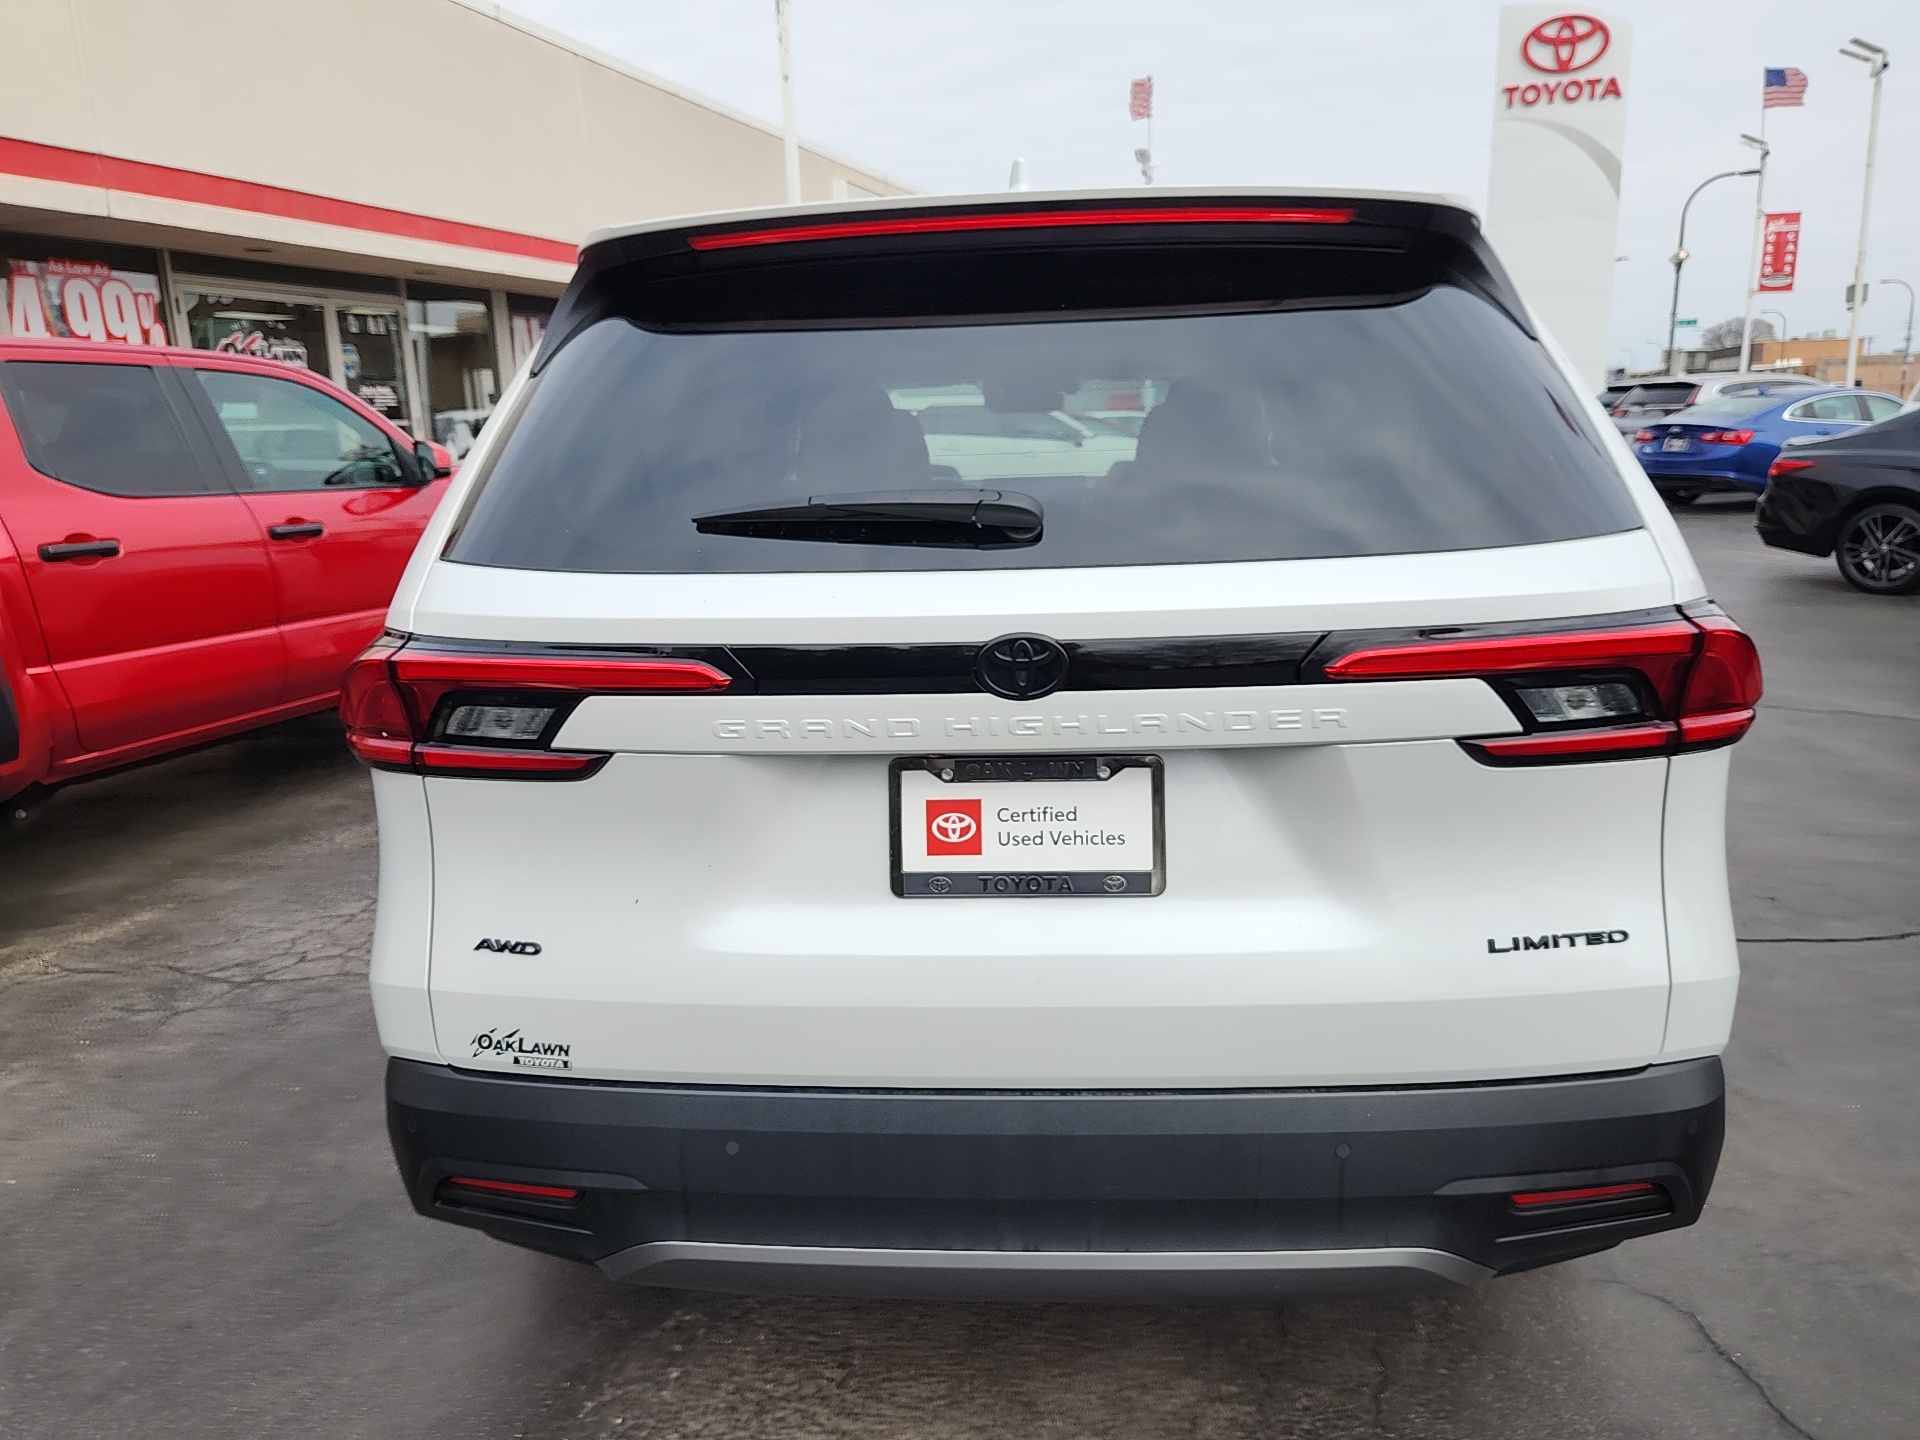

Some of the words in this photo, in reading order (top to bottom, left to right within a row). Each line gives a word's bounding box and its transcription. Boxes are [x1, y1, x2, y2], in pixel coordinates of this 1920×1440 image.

[1503, 76, 1623, 109] TOYOTA
[713, 717, 920, 740] GRAND
[944, 707, 1349, 738] HIGHLANDER
[965, 761, 1013, 778] OAK
[997, 806, 1078, 822] Certified
[997, 830, 1044, 846] Used
[1049, 829, 1126, 846] Vehicles
[977, 875, 1075, 893] TOYOTA
[473, 938, 543, 956] AWD
[1487, 929, 1629, 954] LIMITED
[518, 1056, 565, 1069] TOYOTA
